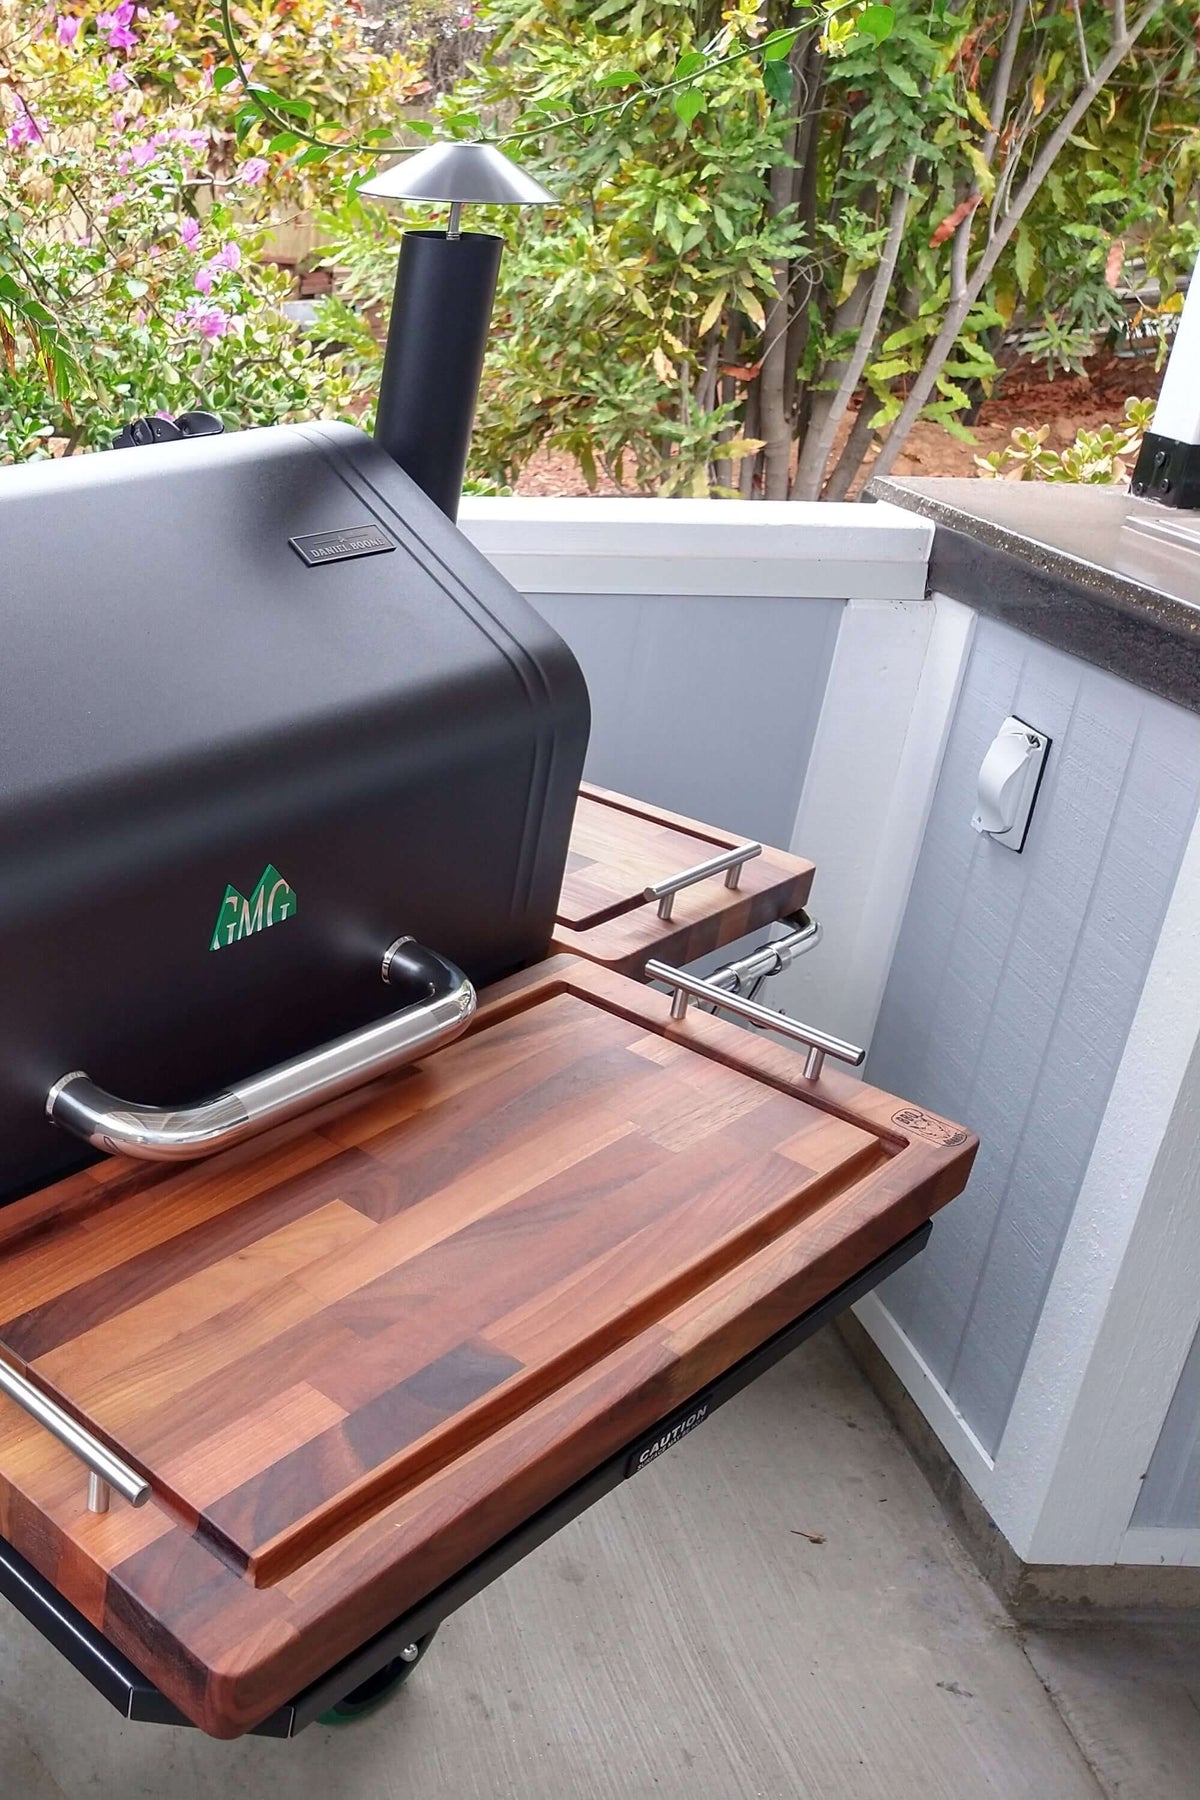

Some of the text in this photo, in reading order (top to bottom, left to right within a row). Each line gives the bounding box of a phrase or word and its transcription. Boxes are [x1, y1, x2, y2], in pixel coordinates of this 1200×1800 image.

[310, 537, 385, 558] DANIEL BOONE
[639, 1405, 707, 1463] CAUTION
